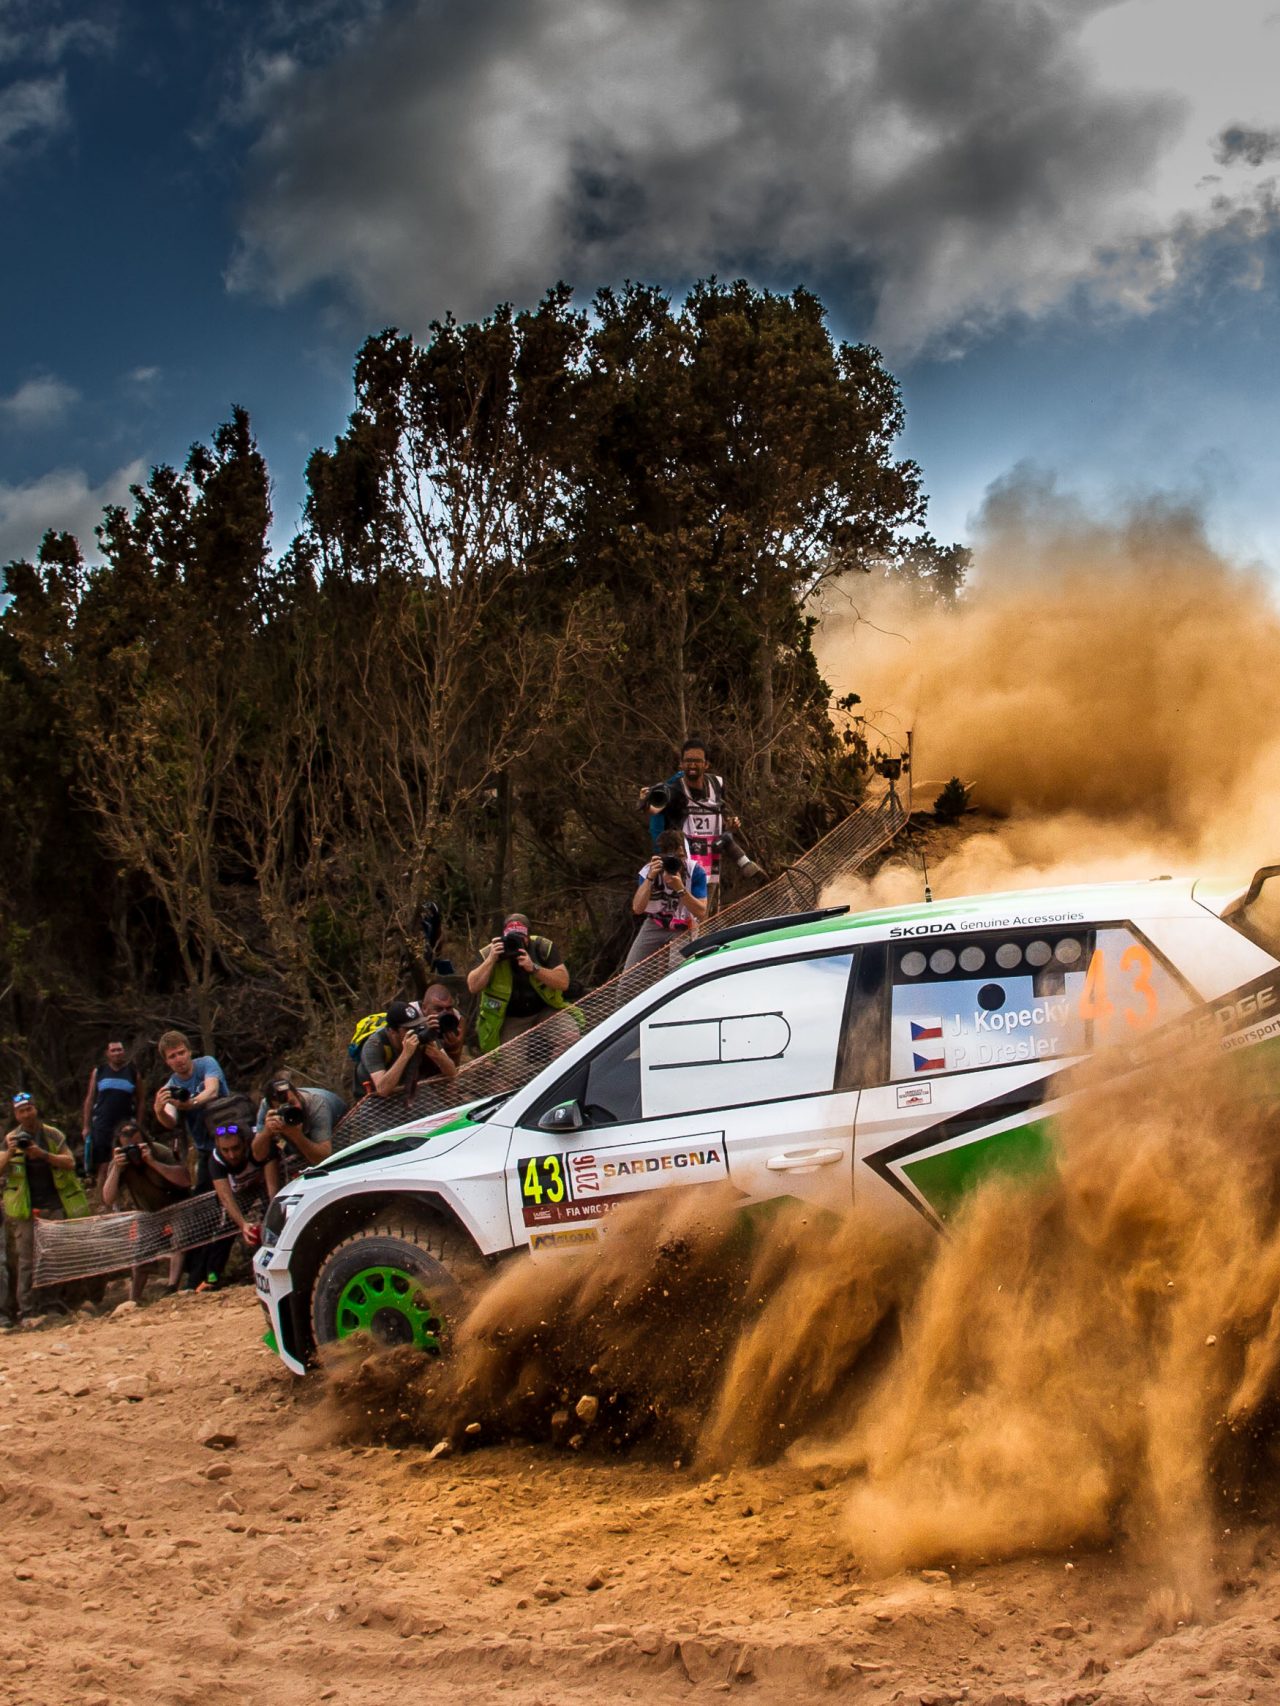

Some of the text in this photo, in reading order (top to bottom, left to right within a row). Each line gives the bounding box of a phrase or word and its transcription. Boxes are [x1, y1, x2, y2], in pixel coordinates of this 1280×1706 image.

[890, 911, 1084, 938] ŠKODA Genuine Accessories
[1078, 944, 1158, 1031] 43
[949, 998, 1071, 1037] J. Kopecký
[952, 1037, 1059, 1068] P. Dresler
[523, 1154, 565, 1205] 43
[572, 1153, 600, 1194] 2016
[603, 1149, 721, 1178] SARDEGNA
[566, 1206, 581, 1217] FIA
[581, 1204, 601, 1215] WRC
[604, 1203, 610, 1212] 2
